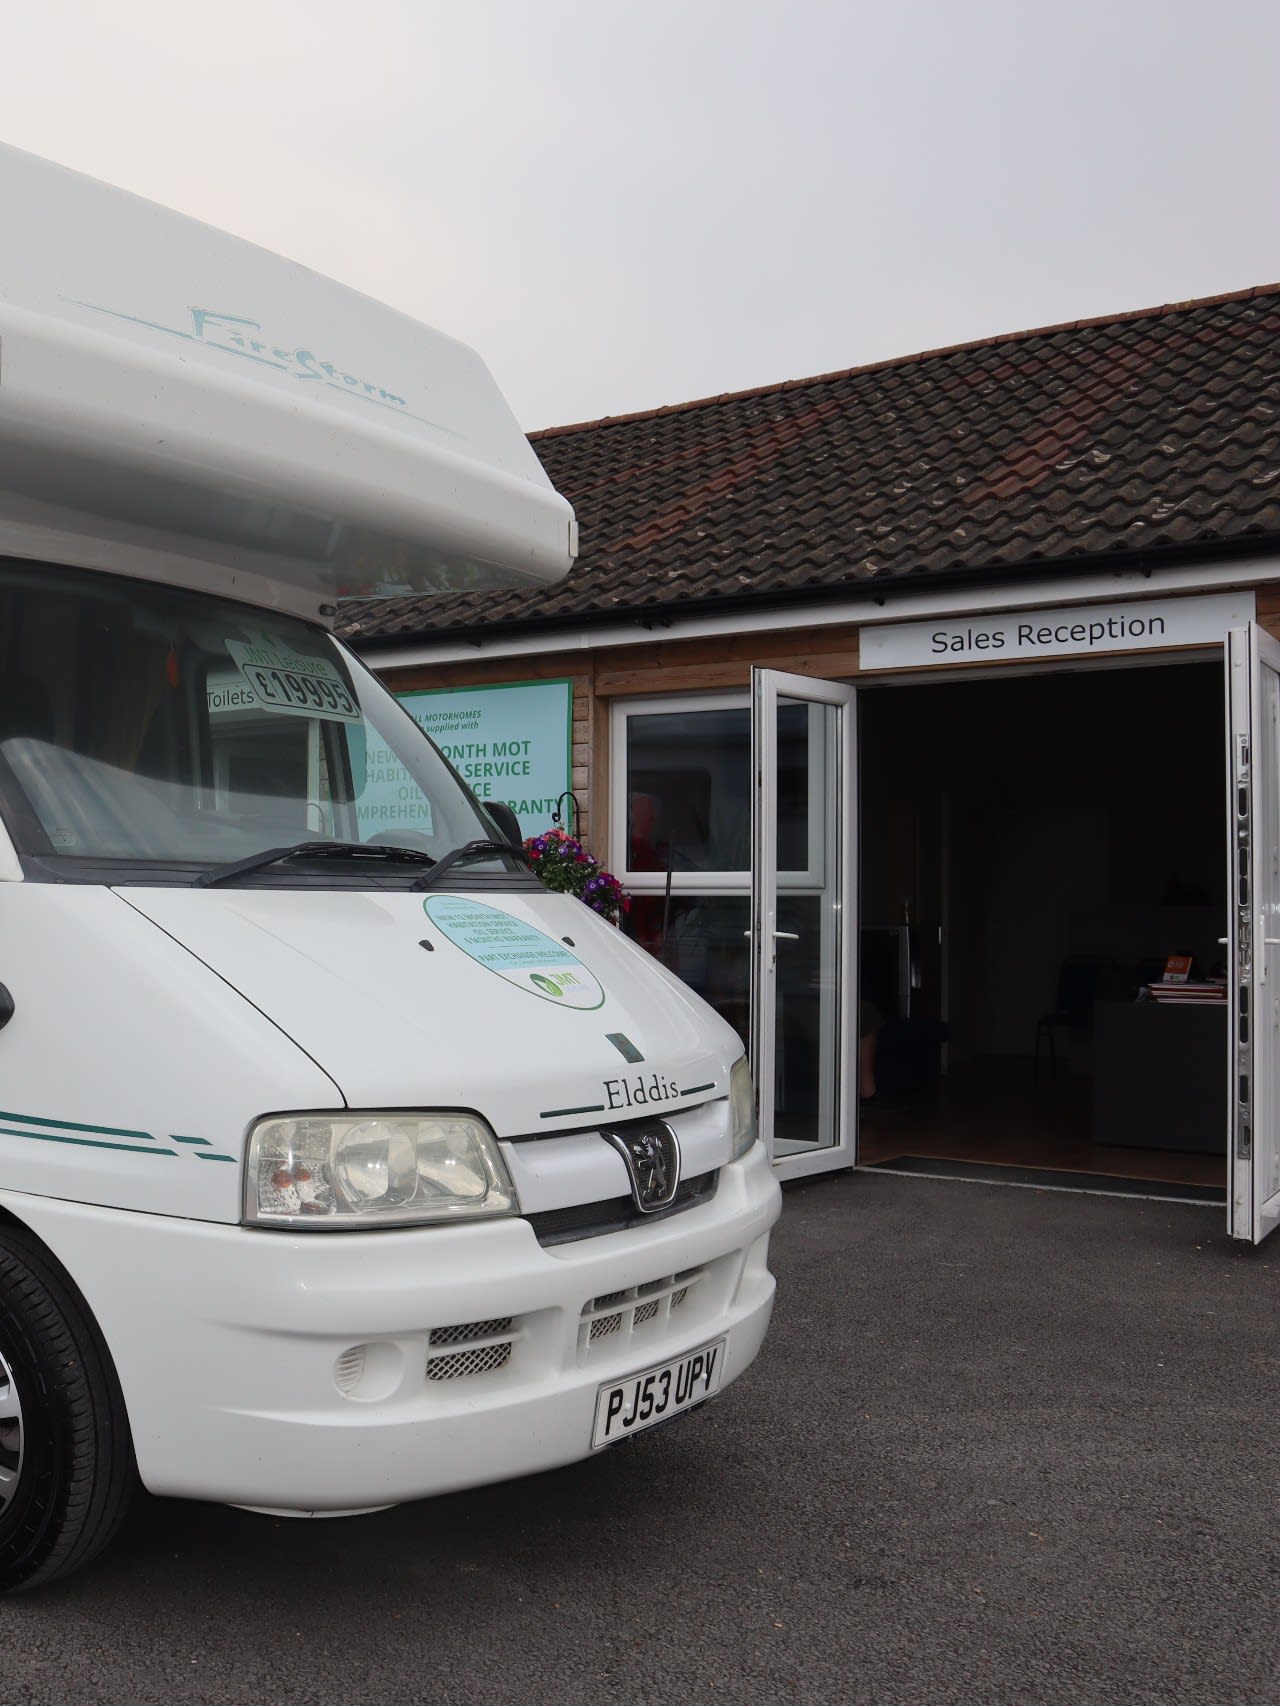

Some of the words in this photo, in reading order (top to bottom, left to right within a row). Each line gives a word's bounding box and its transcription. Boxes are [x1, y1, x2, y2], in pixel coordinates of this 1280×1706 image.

[187, 306, 406, 405] FireStorm
[931, 628, 1006, 654] Sales
[1018, 614, 1166, 646] Reception
[276, 653, 328, 677] Leisure
[206, 688, 255, 708] Toilets
[255, 671, 354, 713] £19995
[424, 710, 482, 722] MOTORHOMES
[426, 722, 460, 734] supplied
[461, 721, 479, 730] with
[440, 744, 487, 759] ONTH
[493, 741, 532, 757] MOT
[464, 760, 531, 778] SERVICE
[398, 786, 423, 801] OIL
[357, 804, 429, 820] MPREHEN
[603, 1073, 679, 1110] Elddis
[604, 1369, 672, 1437] PJ53
